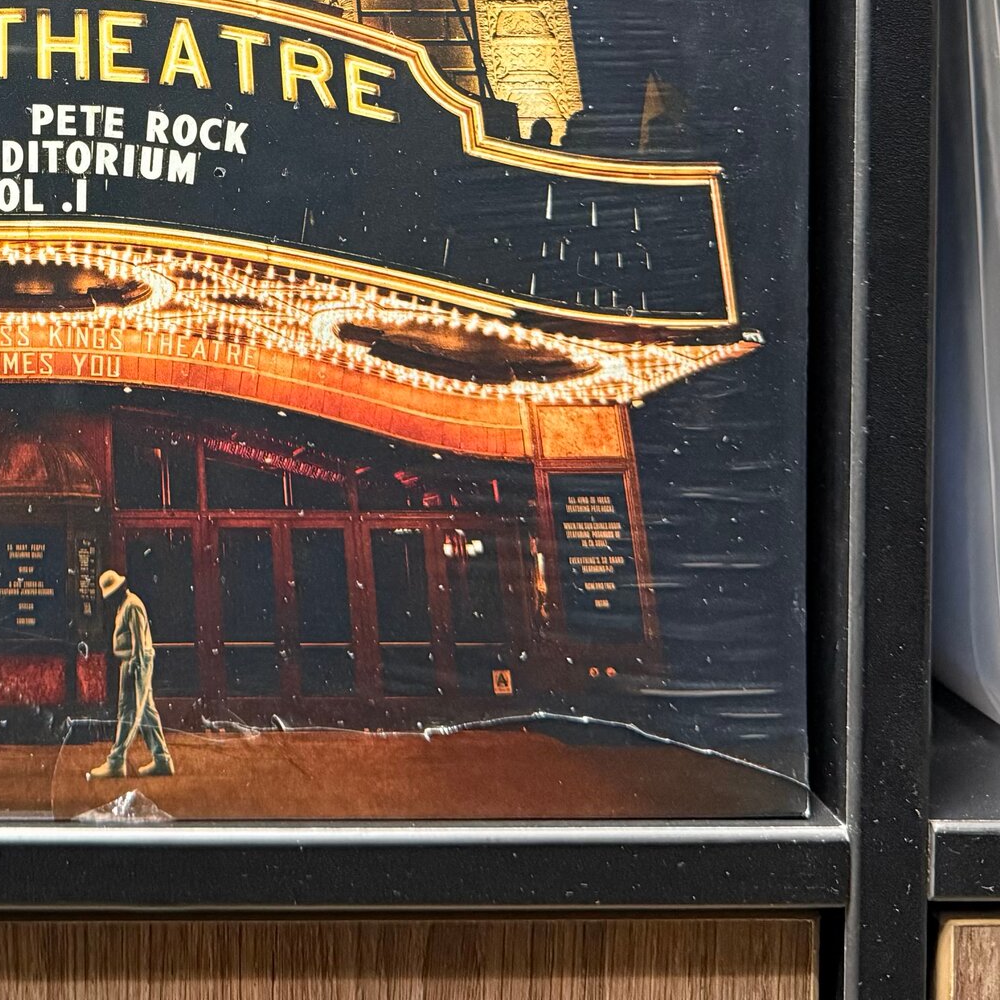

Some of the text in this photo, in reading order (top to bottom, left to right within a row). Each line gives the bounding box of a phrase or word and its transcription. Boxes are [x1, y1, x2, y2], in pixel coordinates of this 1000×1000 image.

[31, 103, 249, 155] PETE ROCK
[48, 325, 124, 351] KINGS
[144, 331, 258, 369] THEATRE
[72, 353, 121, 378] YOU
